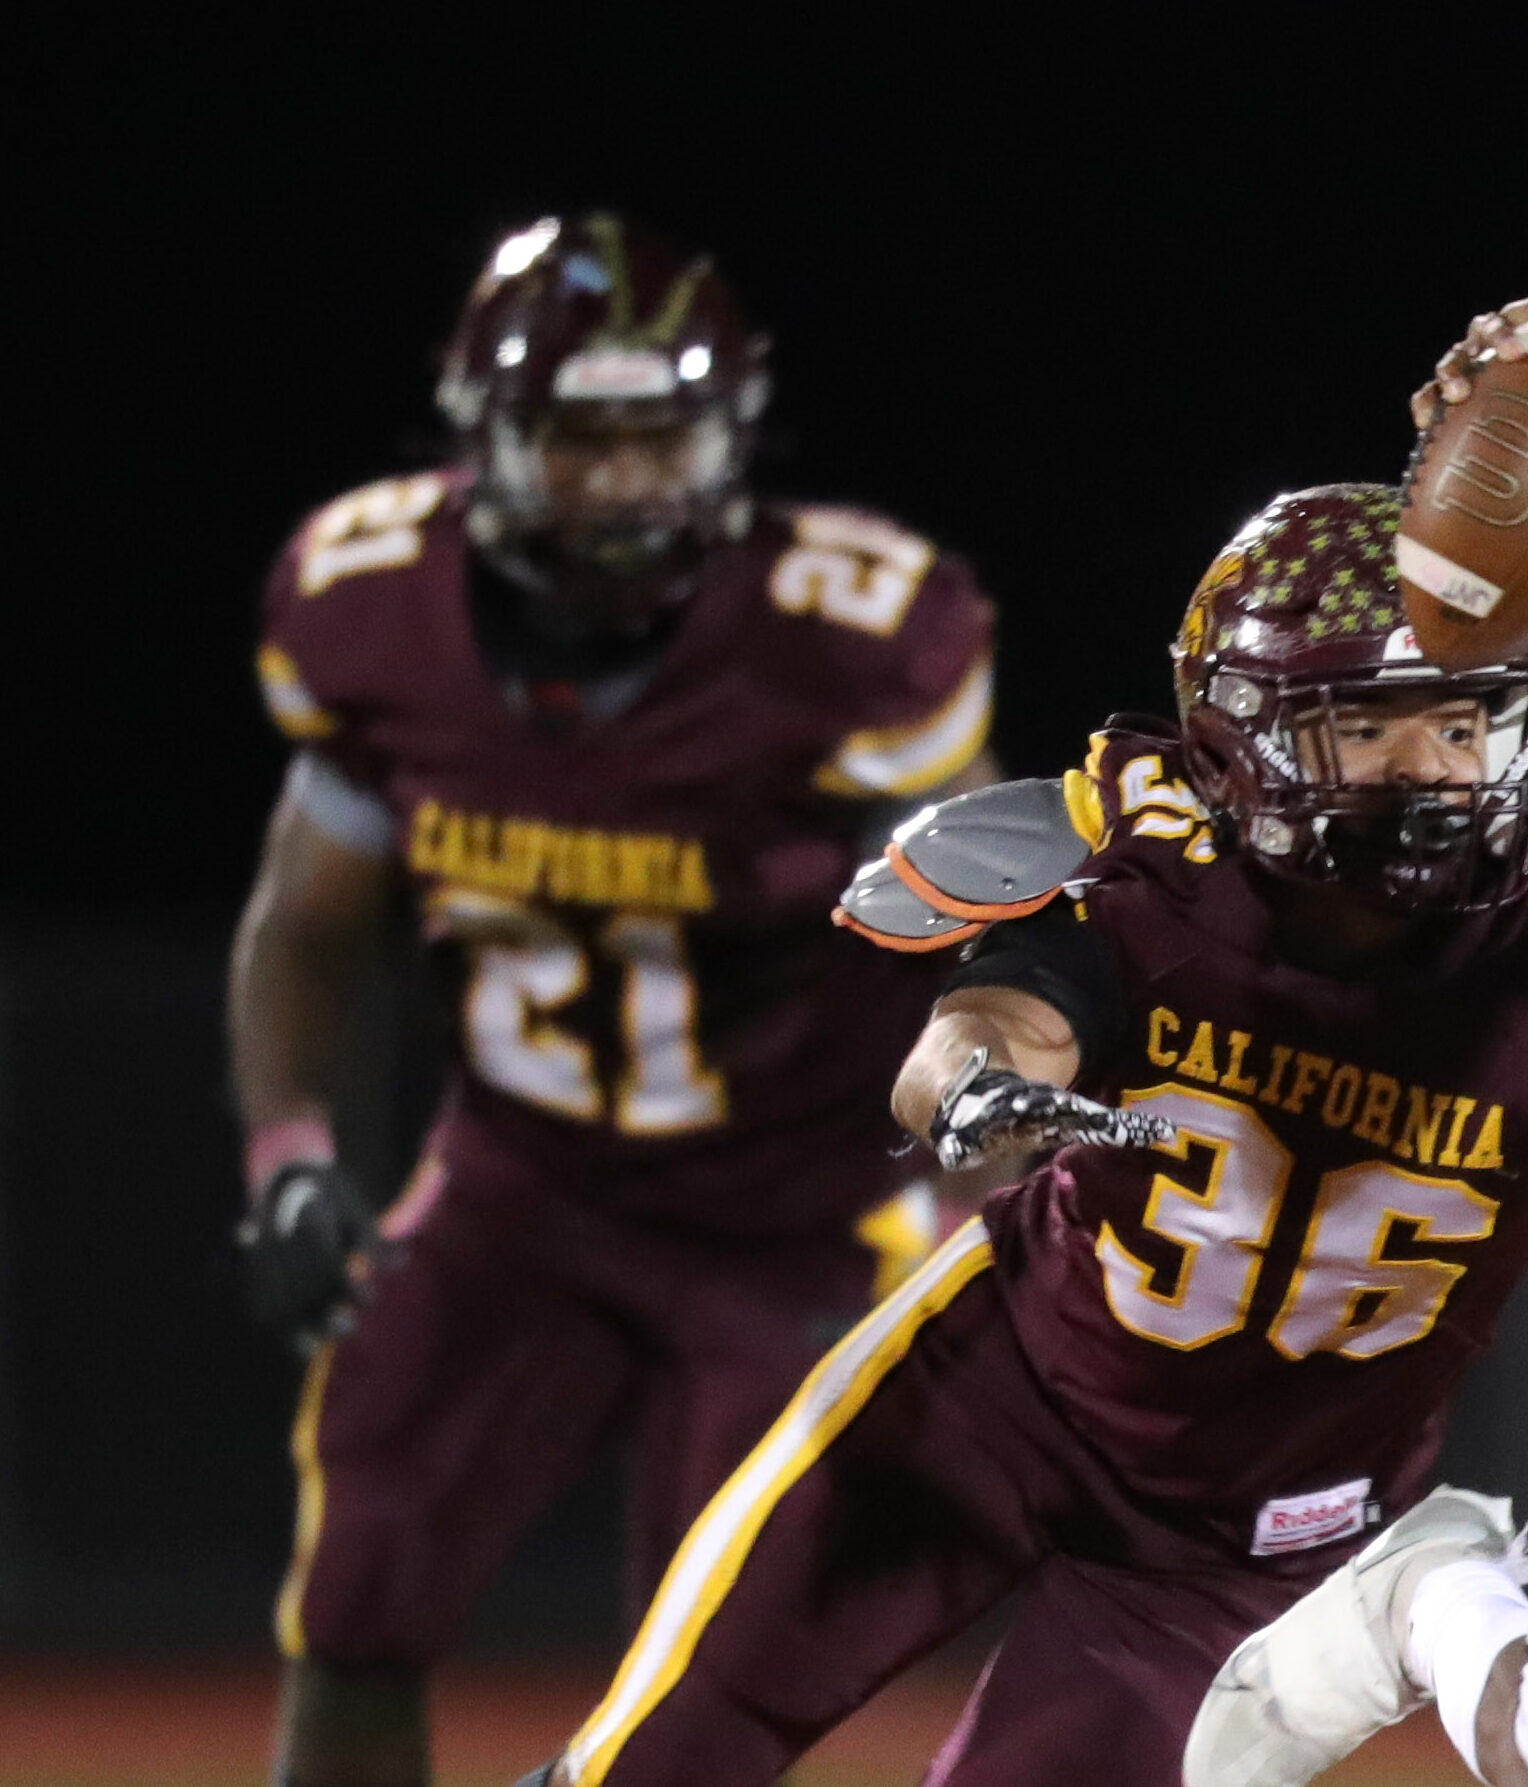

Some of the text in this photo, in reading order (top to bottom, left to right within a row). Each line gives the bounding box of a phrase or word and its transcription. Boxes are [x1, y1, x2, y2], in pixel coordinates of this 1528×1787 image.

[424, 888, 728, 1138] 21
[1146, 1006, 1505, 1168] CALIFORNIA
[1095, 1082, 1501, 1361] 36
